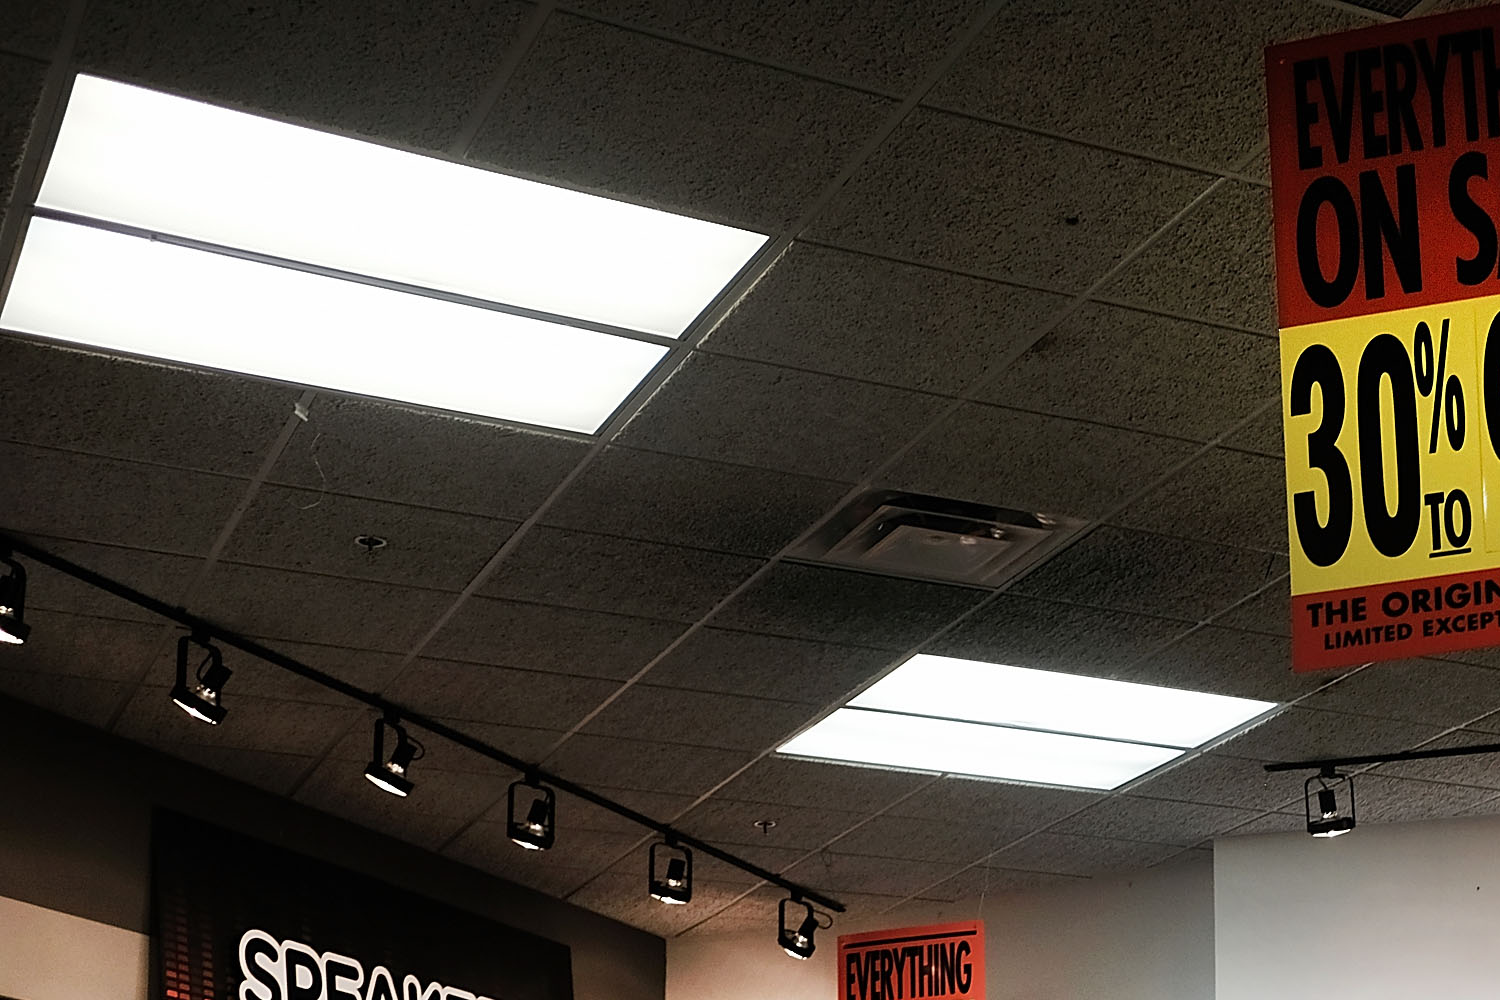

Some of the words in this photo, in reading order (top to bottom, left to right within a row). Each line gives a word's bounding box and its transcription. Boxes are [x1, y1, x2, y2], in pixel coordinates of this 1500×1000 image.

[1297, 164, 1422, 308] ON
[1290, 319, 1466, 567] 30%
[1424, 489, 1471, 550] TO
[1307, 597, 1367, 628] THE
[1324, 623, 1412, 651] LIMITED
